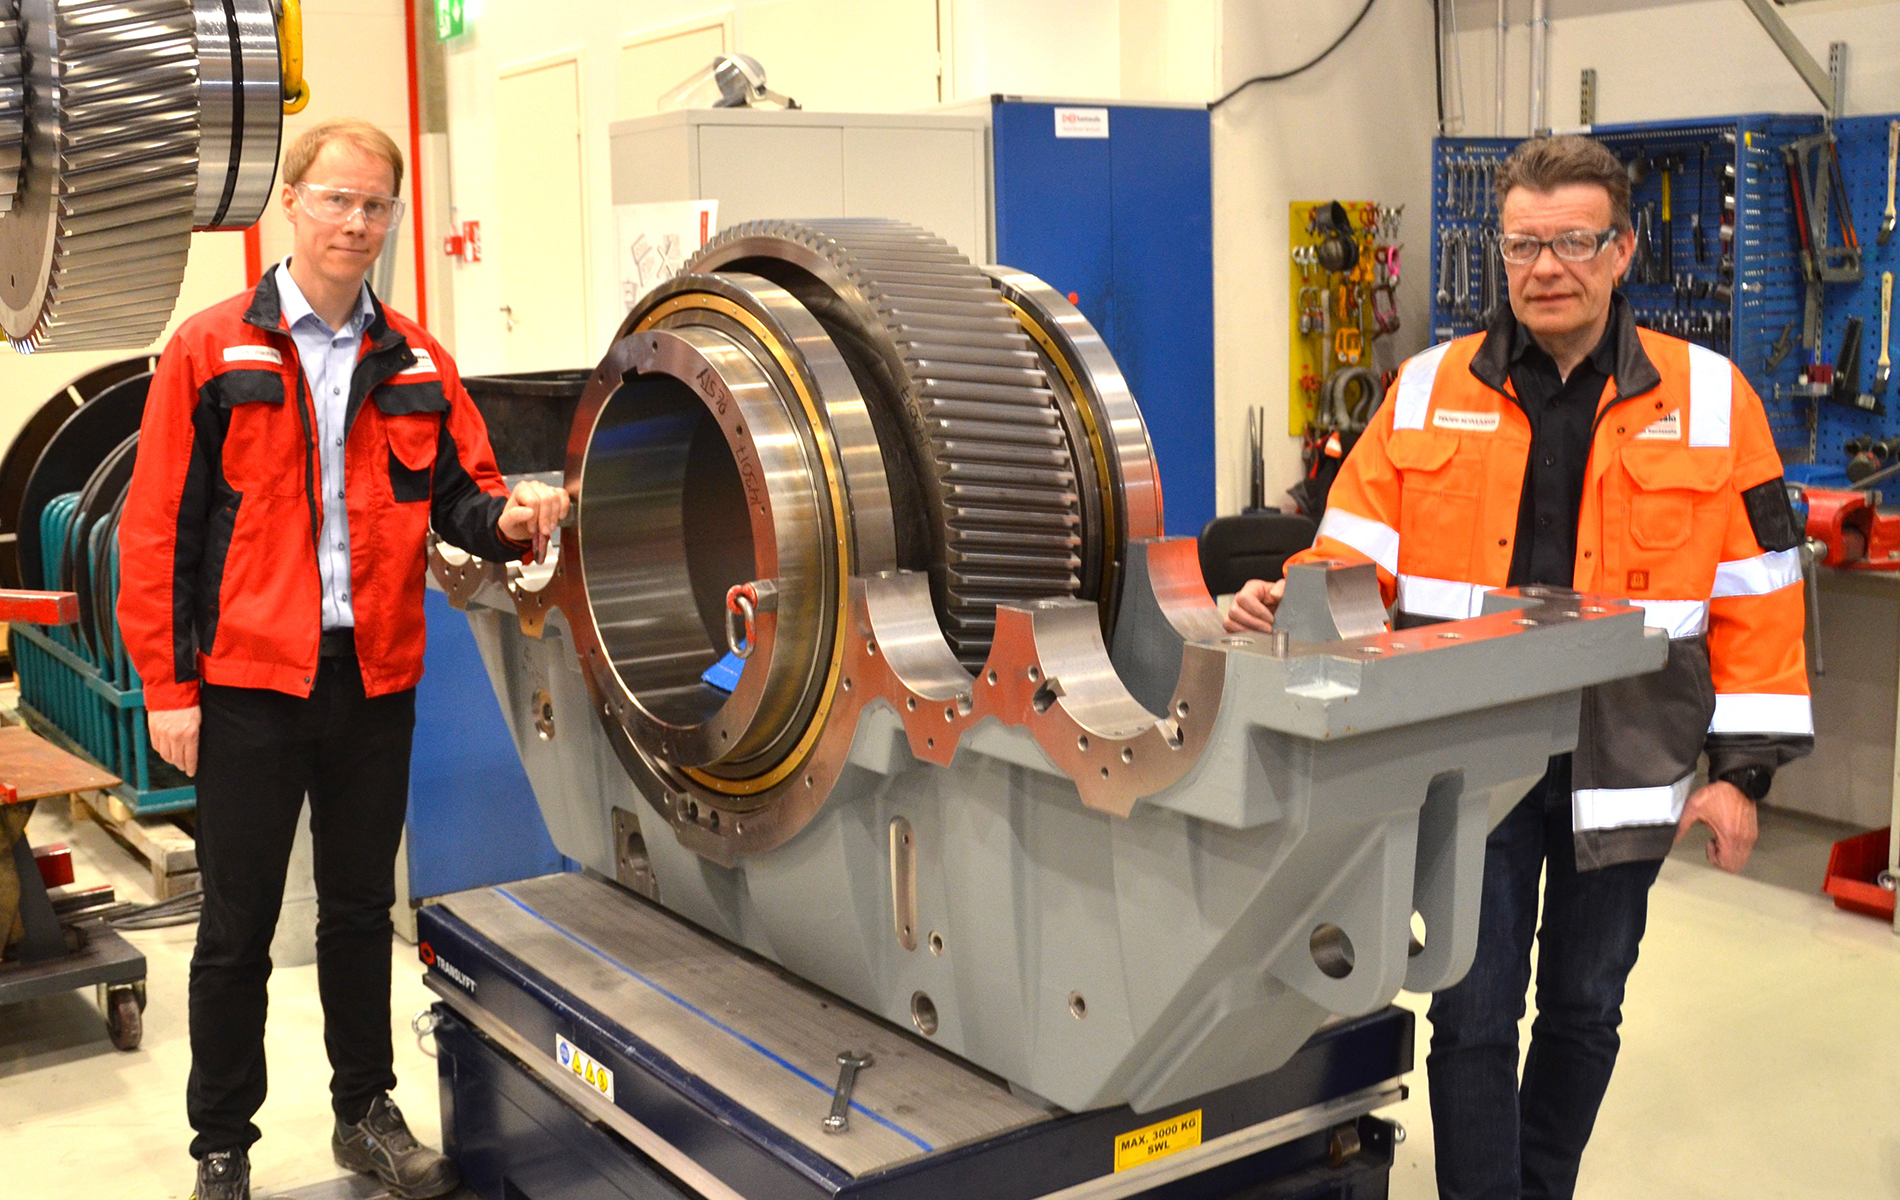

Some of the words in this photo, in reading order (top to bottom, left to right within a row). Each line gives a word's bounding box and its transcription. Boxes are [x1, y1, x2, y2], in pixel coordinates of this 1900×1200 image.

[736, 444, 763, 506] 143017
[436, 954, 477, 993] TRANSLYFT
[1121, 1135, 1149, 1152] MAX.
[1152, 1124, 1178, 1140] 3000
[1181, 1117, 1196, 1131] KG
[1147, 1140, 1170, 1155] SWL
